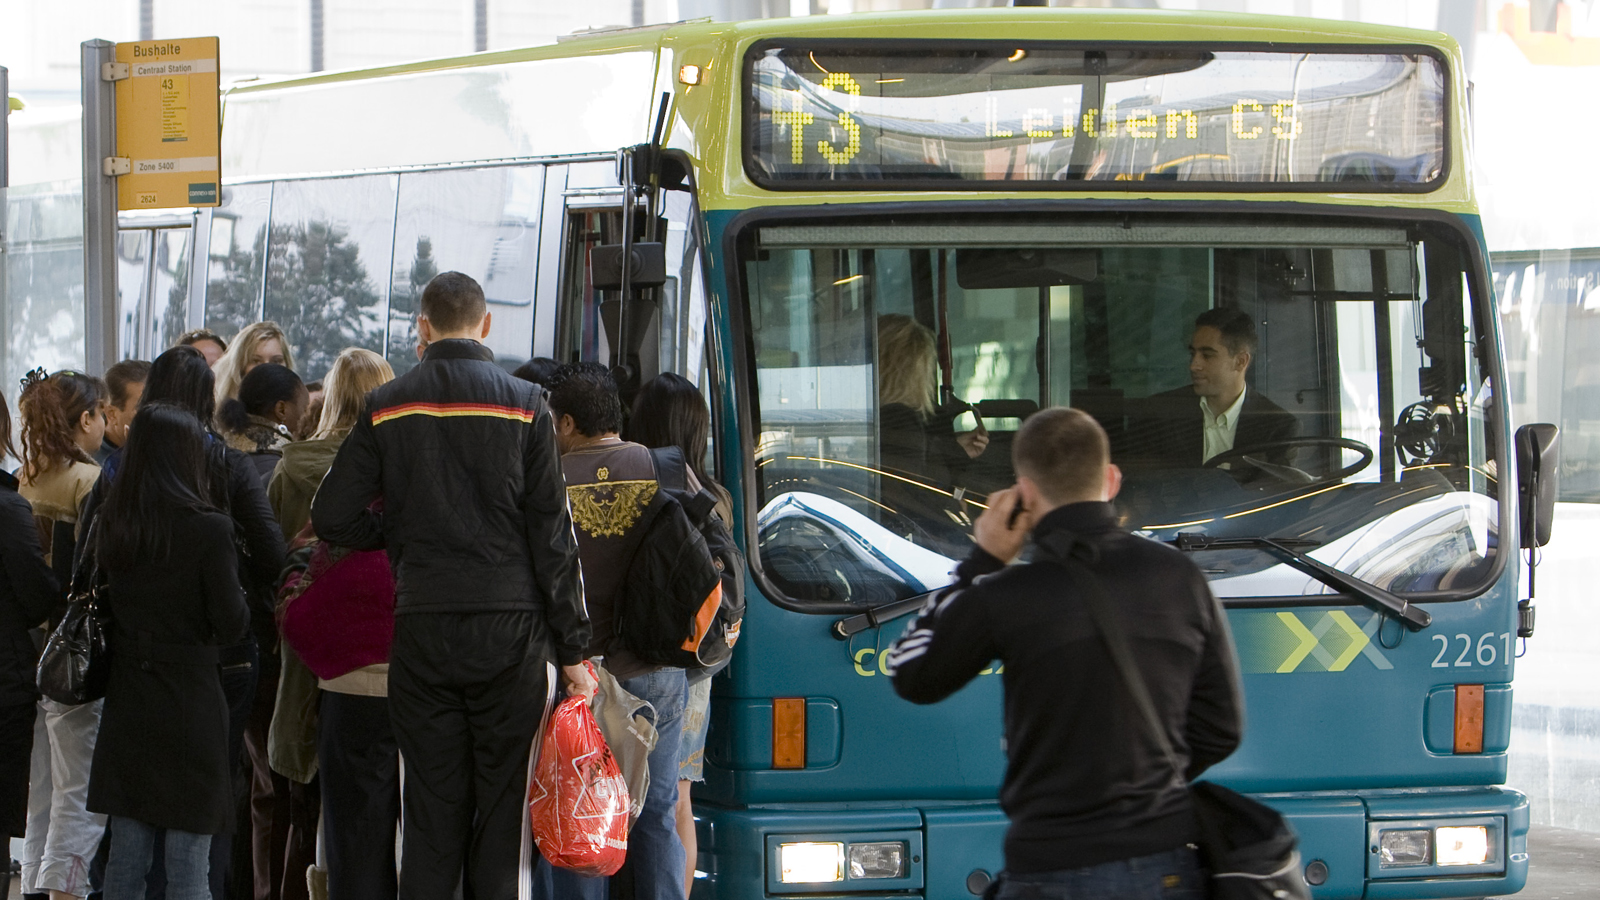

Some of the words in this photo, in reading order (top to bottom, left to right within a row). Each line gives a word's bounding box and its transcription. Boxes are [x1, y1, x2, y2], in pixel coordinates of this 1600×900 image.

[133, 44, 181, 57] Bushalte
[138, 66, 166, 75] Centraal
[168, 64, 192, 73] Station
[161, 79, 174, 90] 43
[772, 72, 860, 164] 43
[985, 96, 1198, 138] Leiden
[1232, 98, 1303, 140] CS
[139, 163, 156, 171] Zone
[158, 162, 175, 171] 5400
[140, 195, 156, 204] 2624
[1430, 631, 1512, 668] 2261
